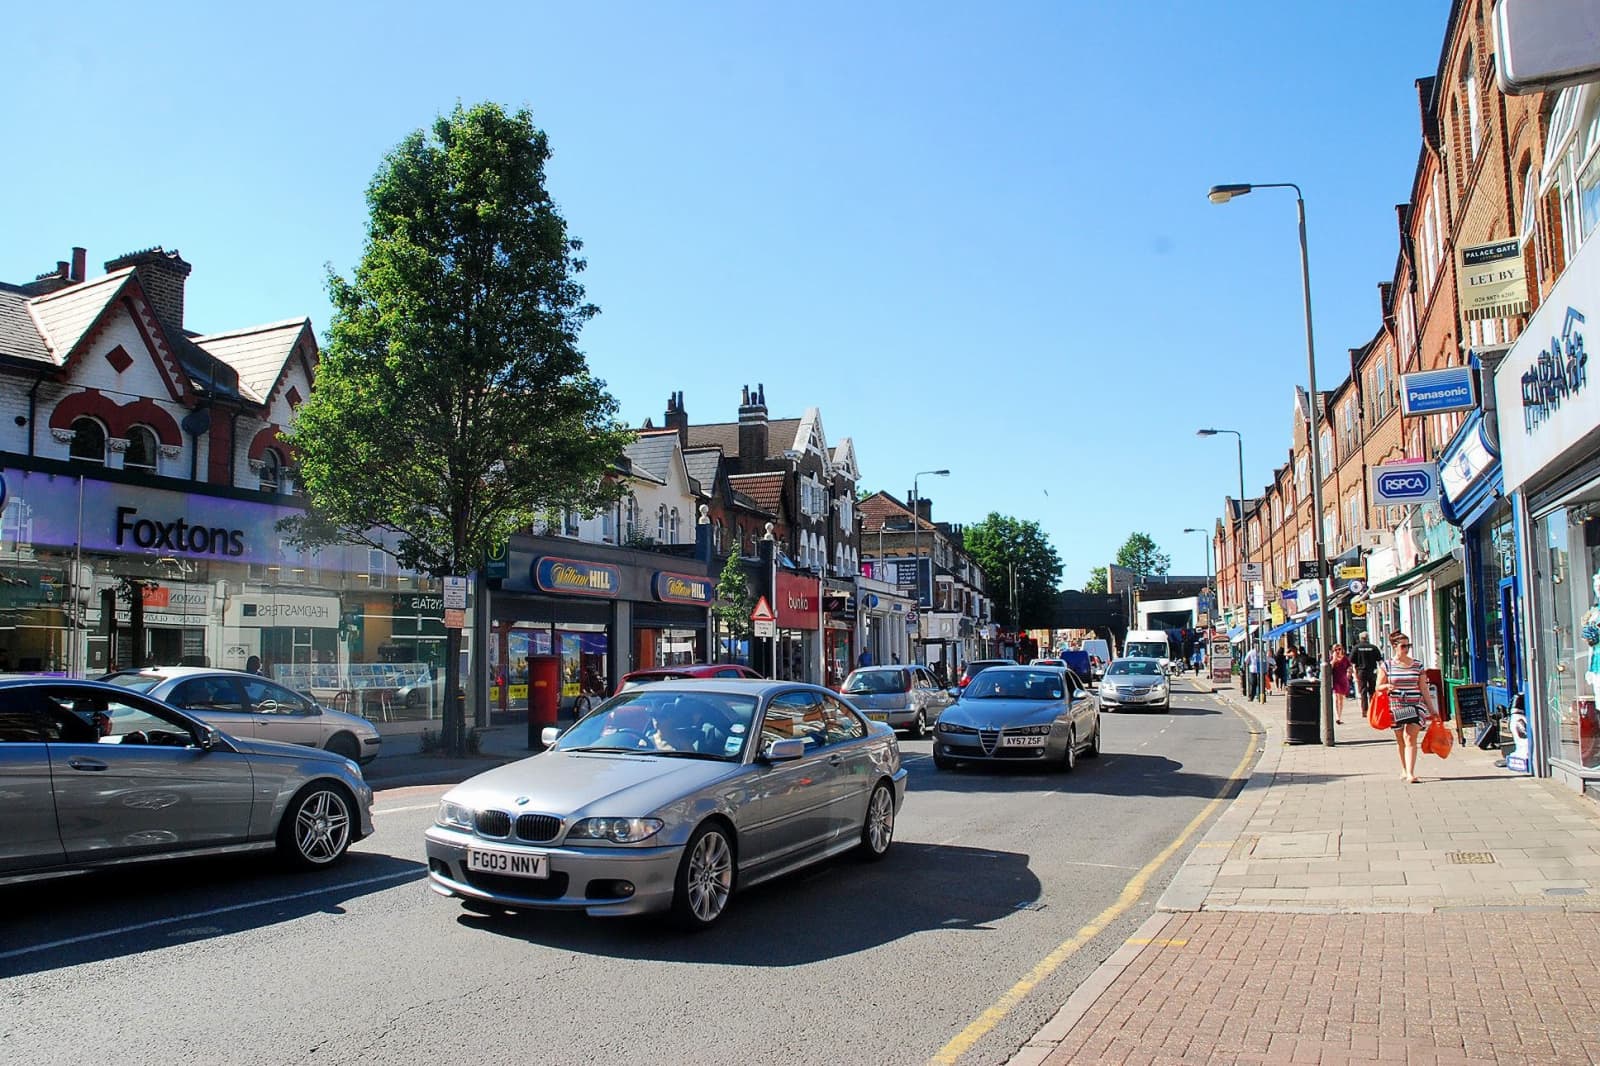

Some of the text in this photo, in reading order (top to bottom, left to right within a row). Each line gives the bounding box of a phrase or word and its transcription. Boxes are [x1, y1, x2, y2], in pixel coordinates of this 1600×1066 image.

[1465, 249, 1495, 258] PALACE
[1496, 244, 1516, 253] GATE
[1470, 268, 1515, 286] LET BY
[1410, 386, 1468, 401] Panasonic
[1385, 478, 1424, 490] RSPCA
[115, 506, 244, 557] Foxtons
[550, 562, 611, 590] William HILL
[666, 576, 706, 599] William HILL
[1006, 737, 1026, 745] AY57
[473, 850, 540, 874] FG03 NNV
